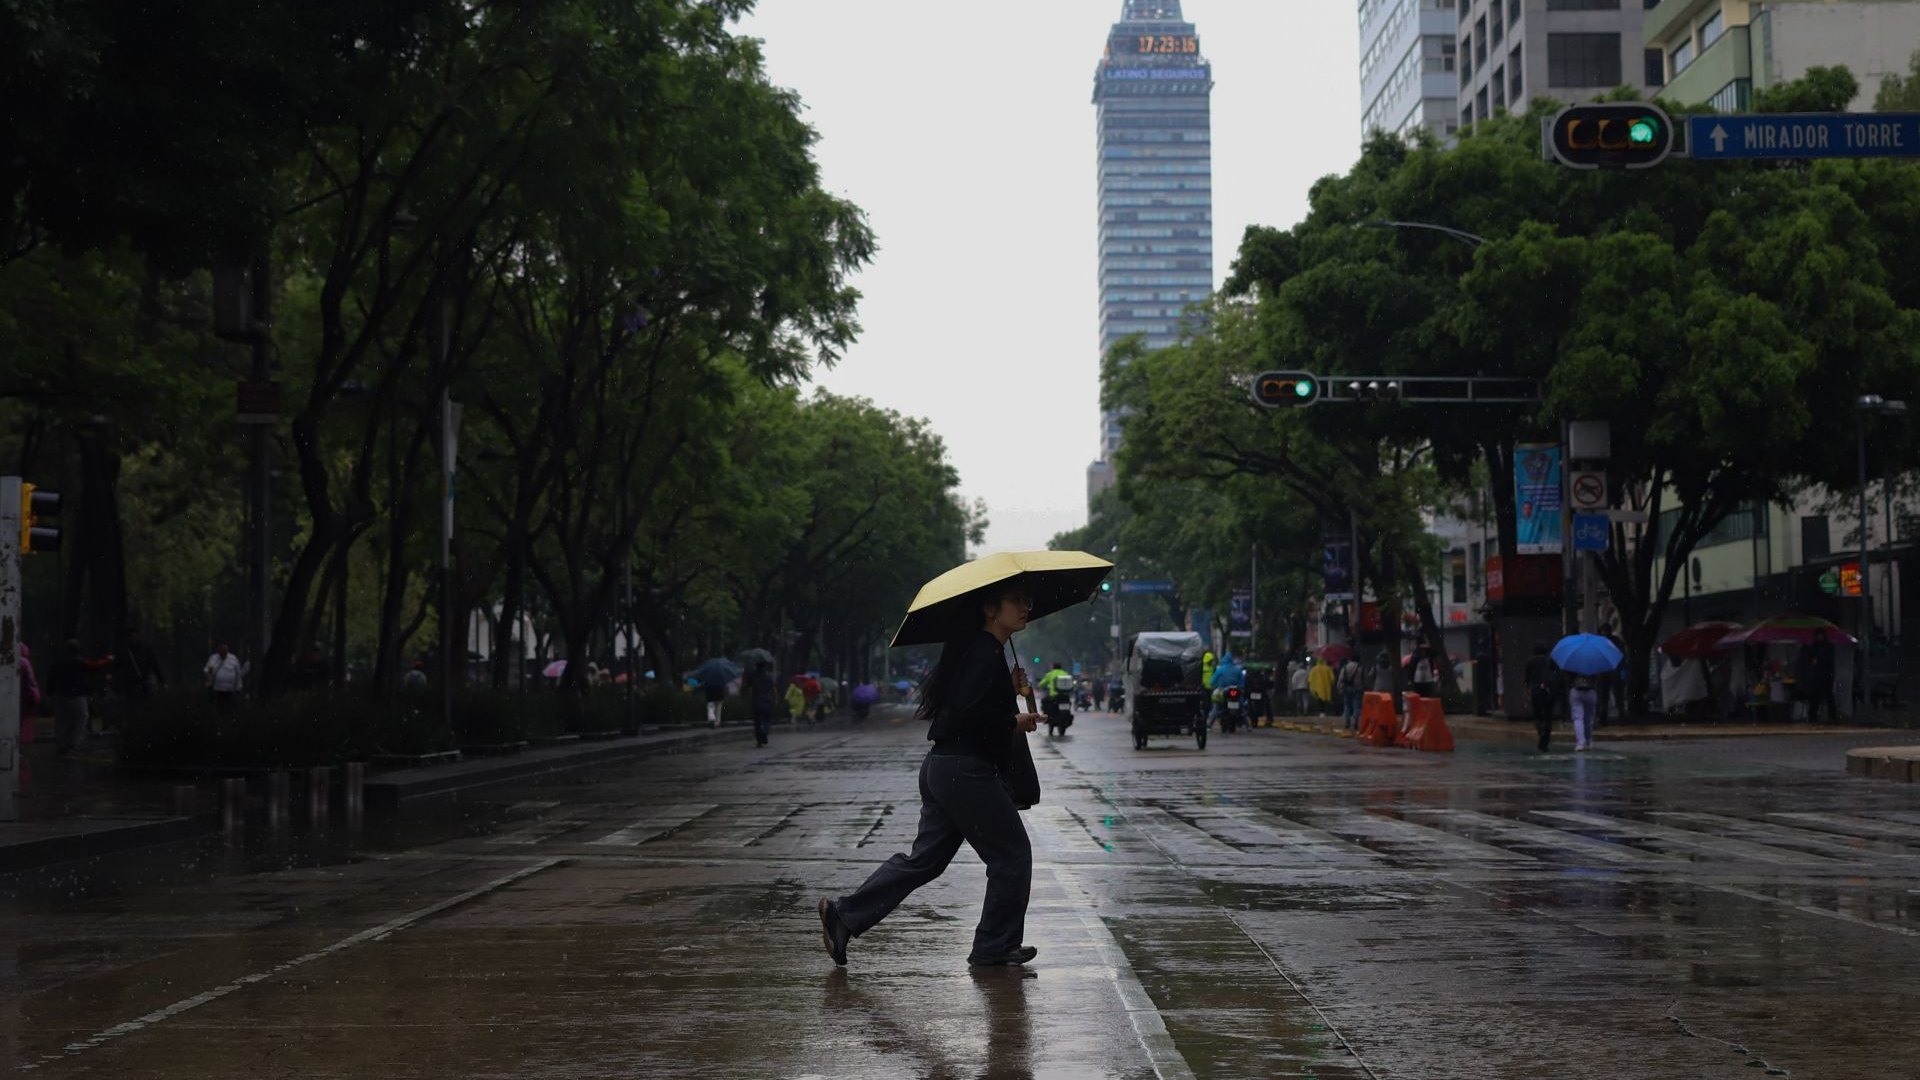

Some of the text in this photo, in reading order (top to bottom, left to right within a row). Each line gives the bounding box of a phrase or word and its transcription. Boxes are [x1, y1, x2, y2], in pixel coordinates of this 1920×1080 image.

[1138, 36, 1196, 53] 17:23:16
[1107, 69, 1205, 79] LATINO SEGUROS
[1744, 123, 1904, 149] MIRADOR TORRE
